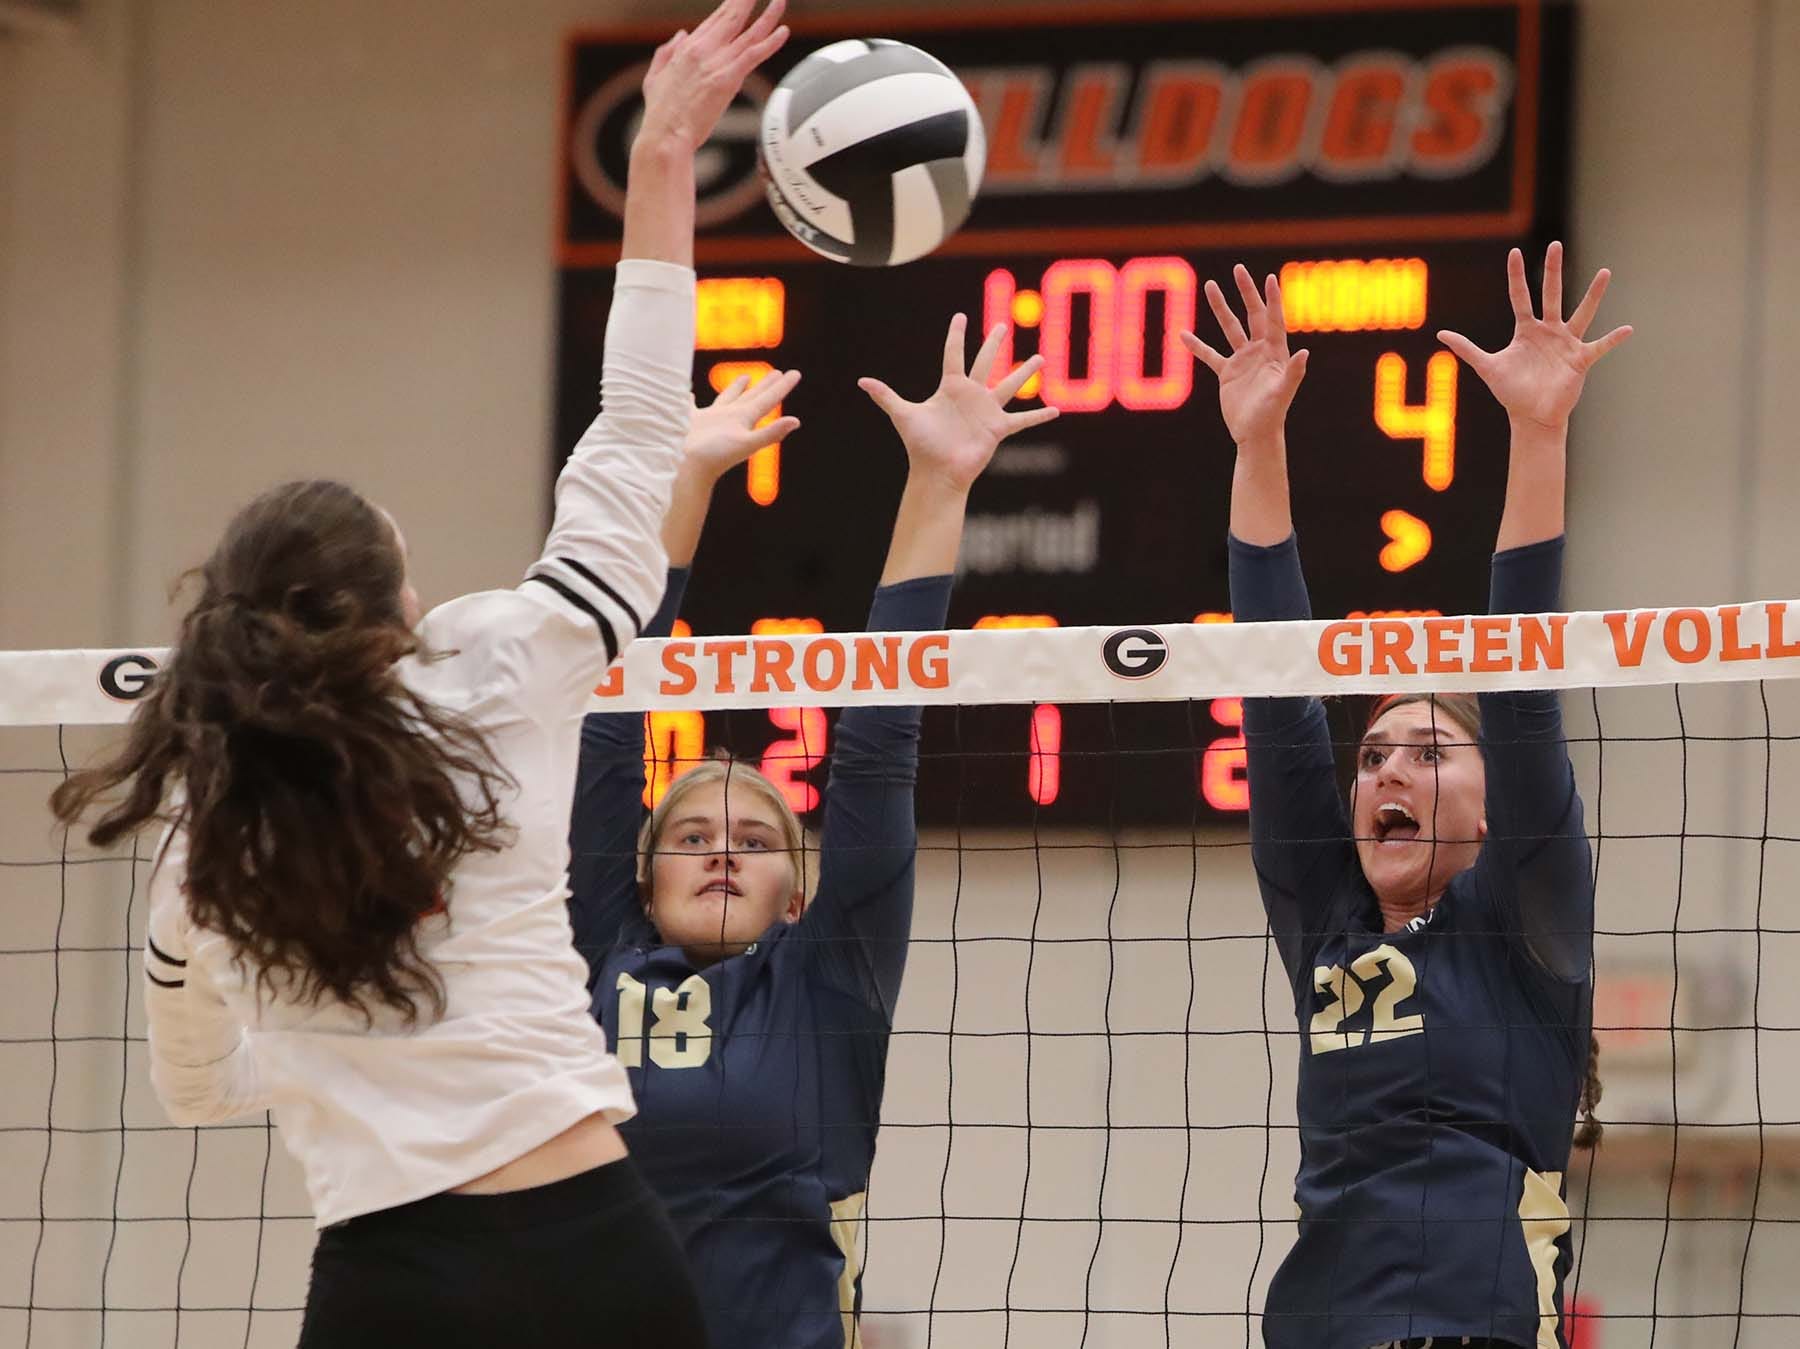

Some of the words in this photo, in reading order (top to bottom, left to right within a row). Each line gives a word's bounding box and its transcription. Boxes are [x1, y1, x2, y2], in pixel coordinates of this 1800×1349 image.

[965, 49, 1514, 190] LLDOGS
[984, 257, 1198, 412] 1:00
[1374, 351, 1458, 491] 4
[97, 652, 163, 703] G
[659, 636, 950, 696] STRONG
[1102, 628, 1169, 680] G
[1318, 614, 1568, 676] GREEN
[1603, 603, 1800, 667] VOLL
[762, 707, 827, 813] 2
[1029, 704, 1062, 806] 1
[616, 972, 712, 1069] 18
[1310, 944, 1425, 1056] 22
